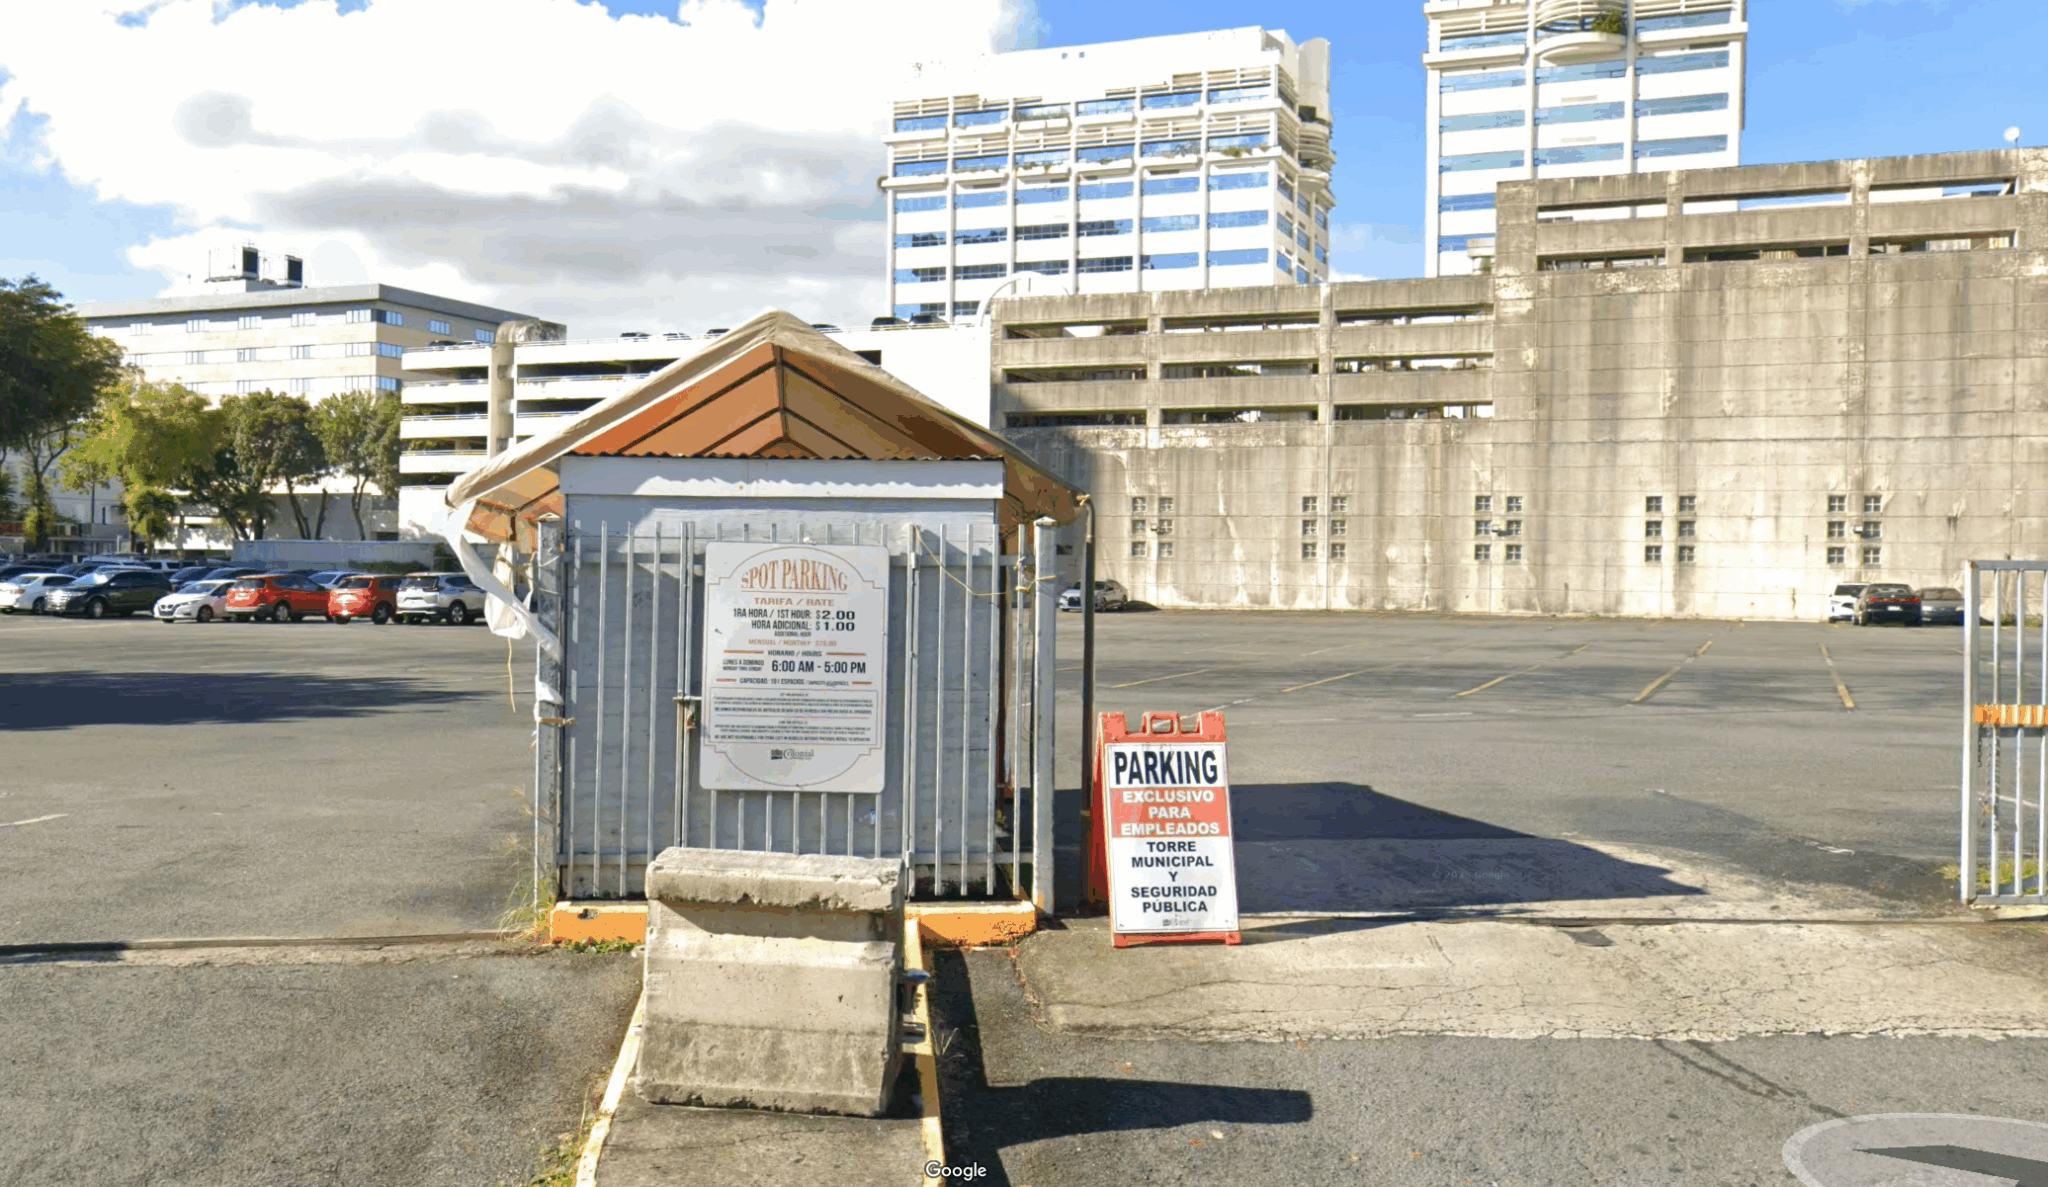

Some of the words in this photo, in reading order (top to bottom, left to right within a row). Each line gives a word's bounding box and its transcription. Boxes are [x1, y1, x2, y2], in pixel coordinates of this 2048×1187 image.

[741, 560, 778, 589] SPOT
[782, 559, 848, 591] PARKING
[753, 597, 793, 605] TARIFA
[806, 599, 835, 607] RATE
[733, 608, 747, 617] 1RA
[749, 609, 768, 618] HORA
[777, 609, 790, 619] 1ST
[791, 610, 813, 619] HOUR:
[751, 620, 771, 629] HORA
[772, 660, 796, 673] 6:00
[798, 660, 814, 673] AM
[824, 661, 848, 674] 5:00
[850, 662, 866, 674] PM
[1114, 750, 1218, 785] PARKING
[1122, 790, 1215, 803] EXCLUSIVO
[1148, 806, 1191, 819] PARA
[1120, 822, 1220, 836] EMPLEADOS
[1146, 841, 1197, 852] TORRE
[1131, 856, 1214, 867] MUNICIPAL
[1168, 871, 1178, 882] Y
[1131, 886, 1217, 898] SEGURIDAD
